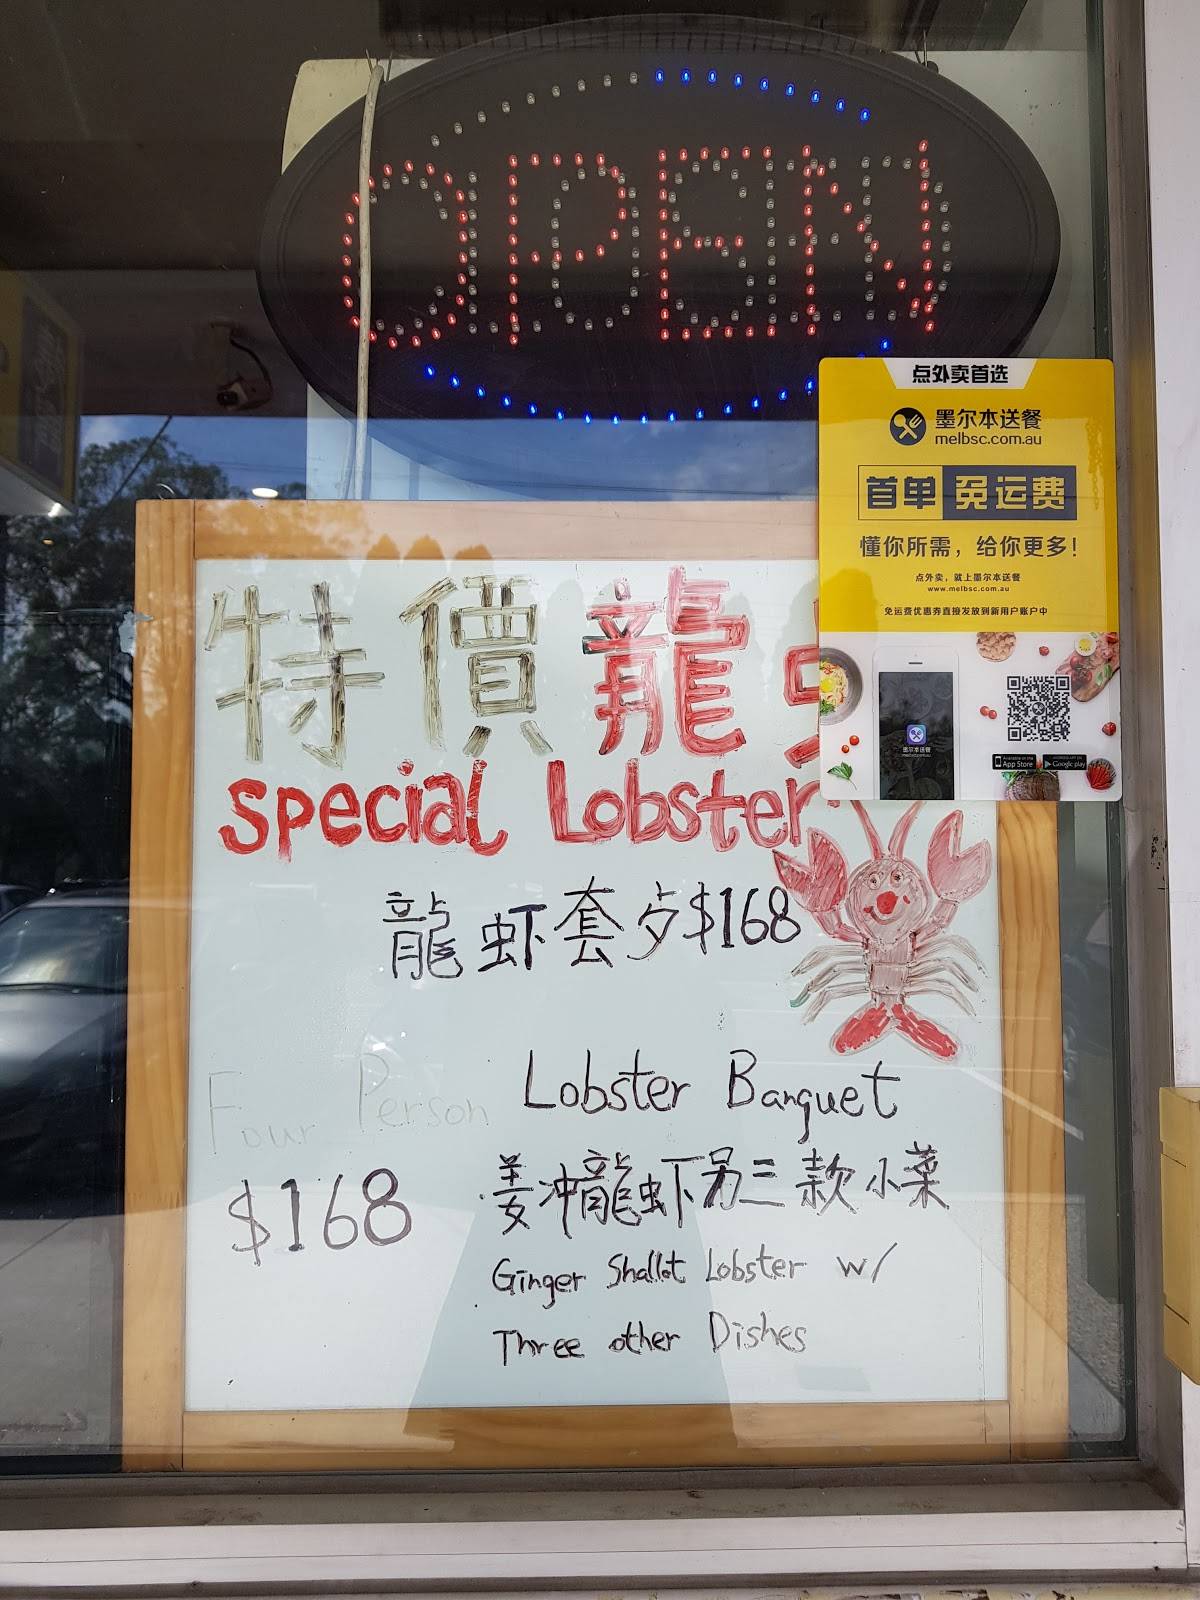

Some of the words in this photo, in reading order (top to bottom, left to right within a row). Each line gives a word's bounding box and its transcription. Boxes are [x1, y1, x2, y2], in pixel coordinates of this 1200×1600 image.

[341, 139, 936, 350] OPEN
[912, 365, 1009, 384] 点外卖首选
[935, 408, 1042, 430] 墨尔本送餐
[935, 432, 1042, 445] melbsc.com.au
[866, 476, 936, 510] 首单
[955, 475, 1065, 510] 免运费
[927, 585, 1010, 593] www.melbsc.com.au
[204, 566, 819, 768] 特價龍
[1003, 760, 1016, 768] App
[1017, 760, 1034, 768] Store
[1052, 760, 1073, 769] Google
[546, 759, 820, 850] Lobster
[208, 1070, 317, 1154] Four
[358, 1052, 491, 1131] Person
[523, 1049, 692, 1114] Lobster
[228, 1168, 412, 1266] $168
[492, 1258, 587, 1309] Ginger
[705, 1244, 808, 1283] Lobster
[492, 1330, 585, 1366] Three
[608, 1321, 681, 1355] other
[708, 1311, 807, 1353] Dishes
